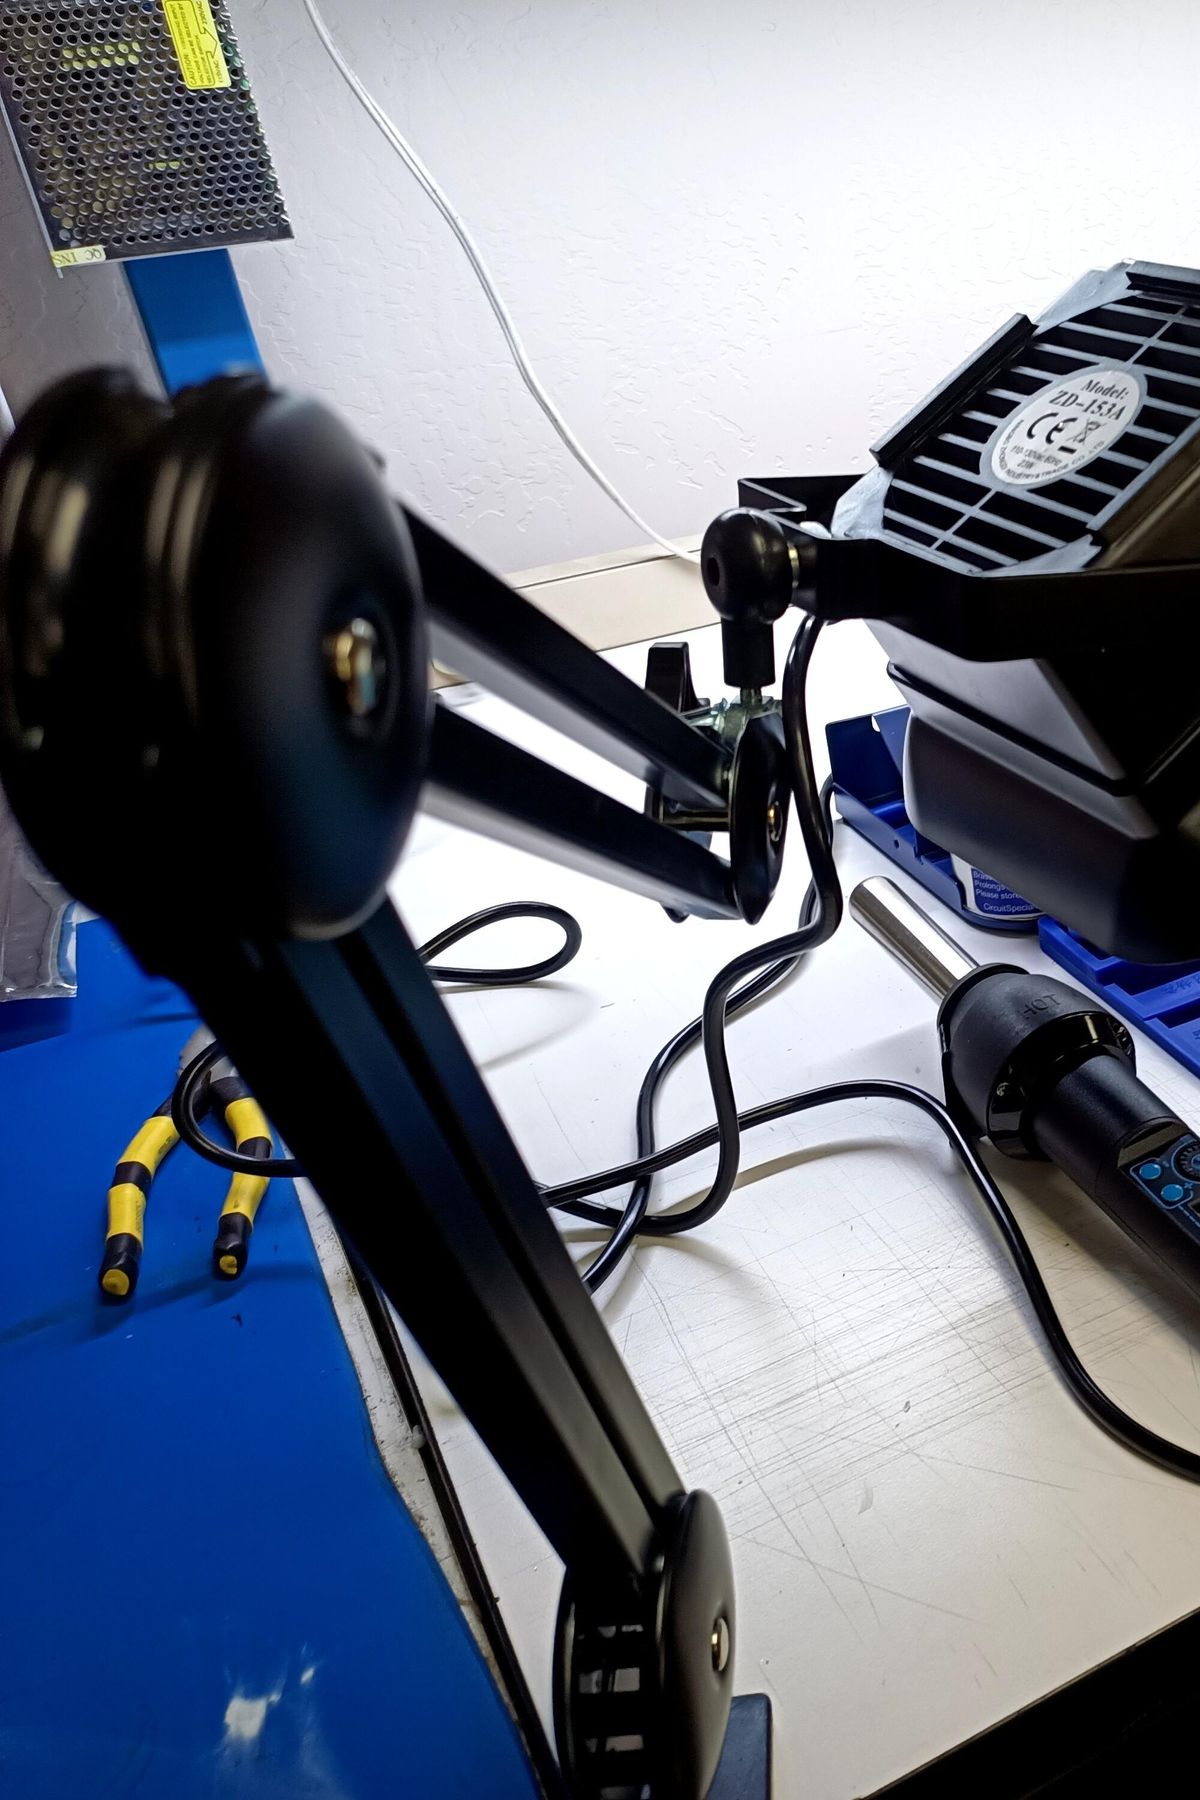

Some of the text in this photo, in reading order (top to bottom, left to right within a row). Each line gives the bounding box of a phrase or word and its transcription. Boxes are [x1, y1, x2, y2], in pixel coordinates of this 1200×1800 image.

[183, 54, 197, 85] CAUTION
[84, 247, 102, 261] QC
[1082, 378, 1130, 401] Model:
[1049, 389, 1127, 421] ZD-153A
[975, 888, 999, 899] Please
